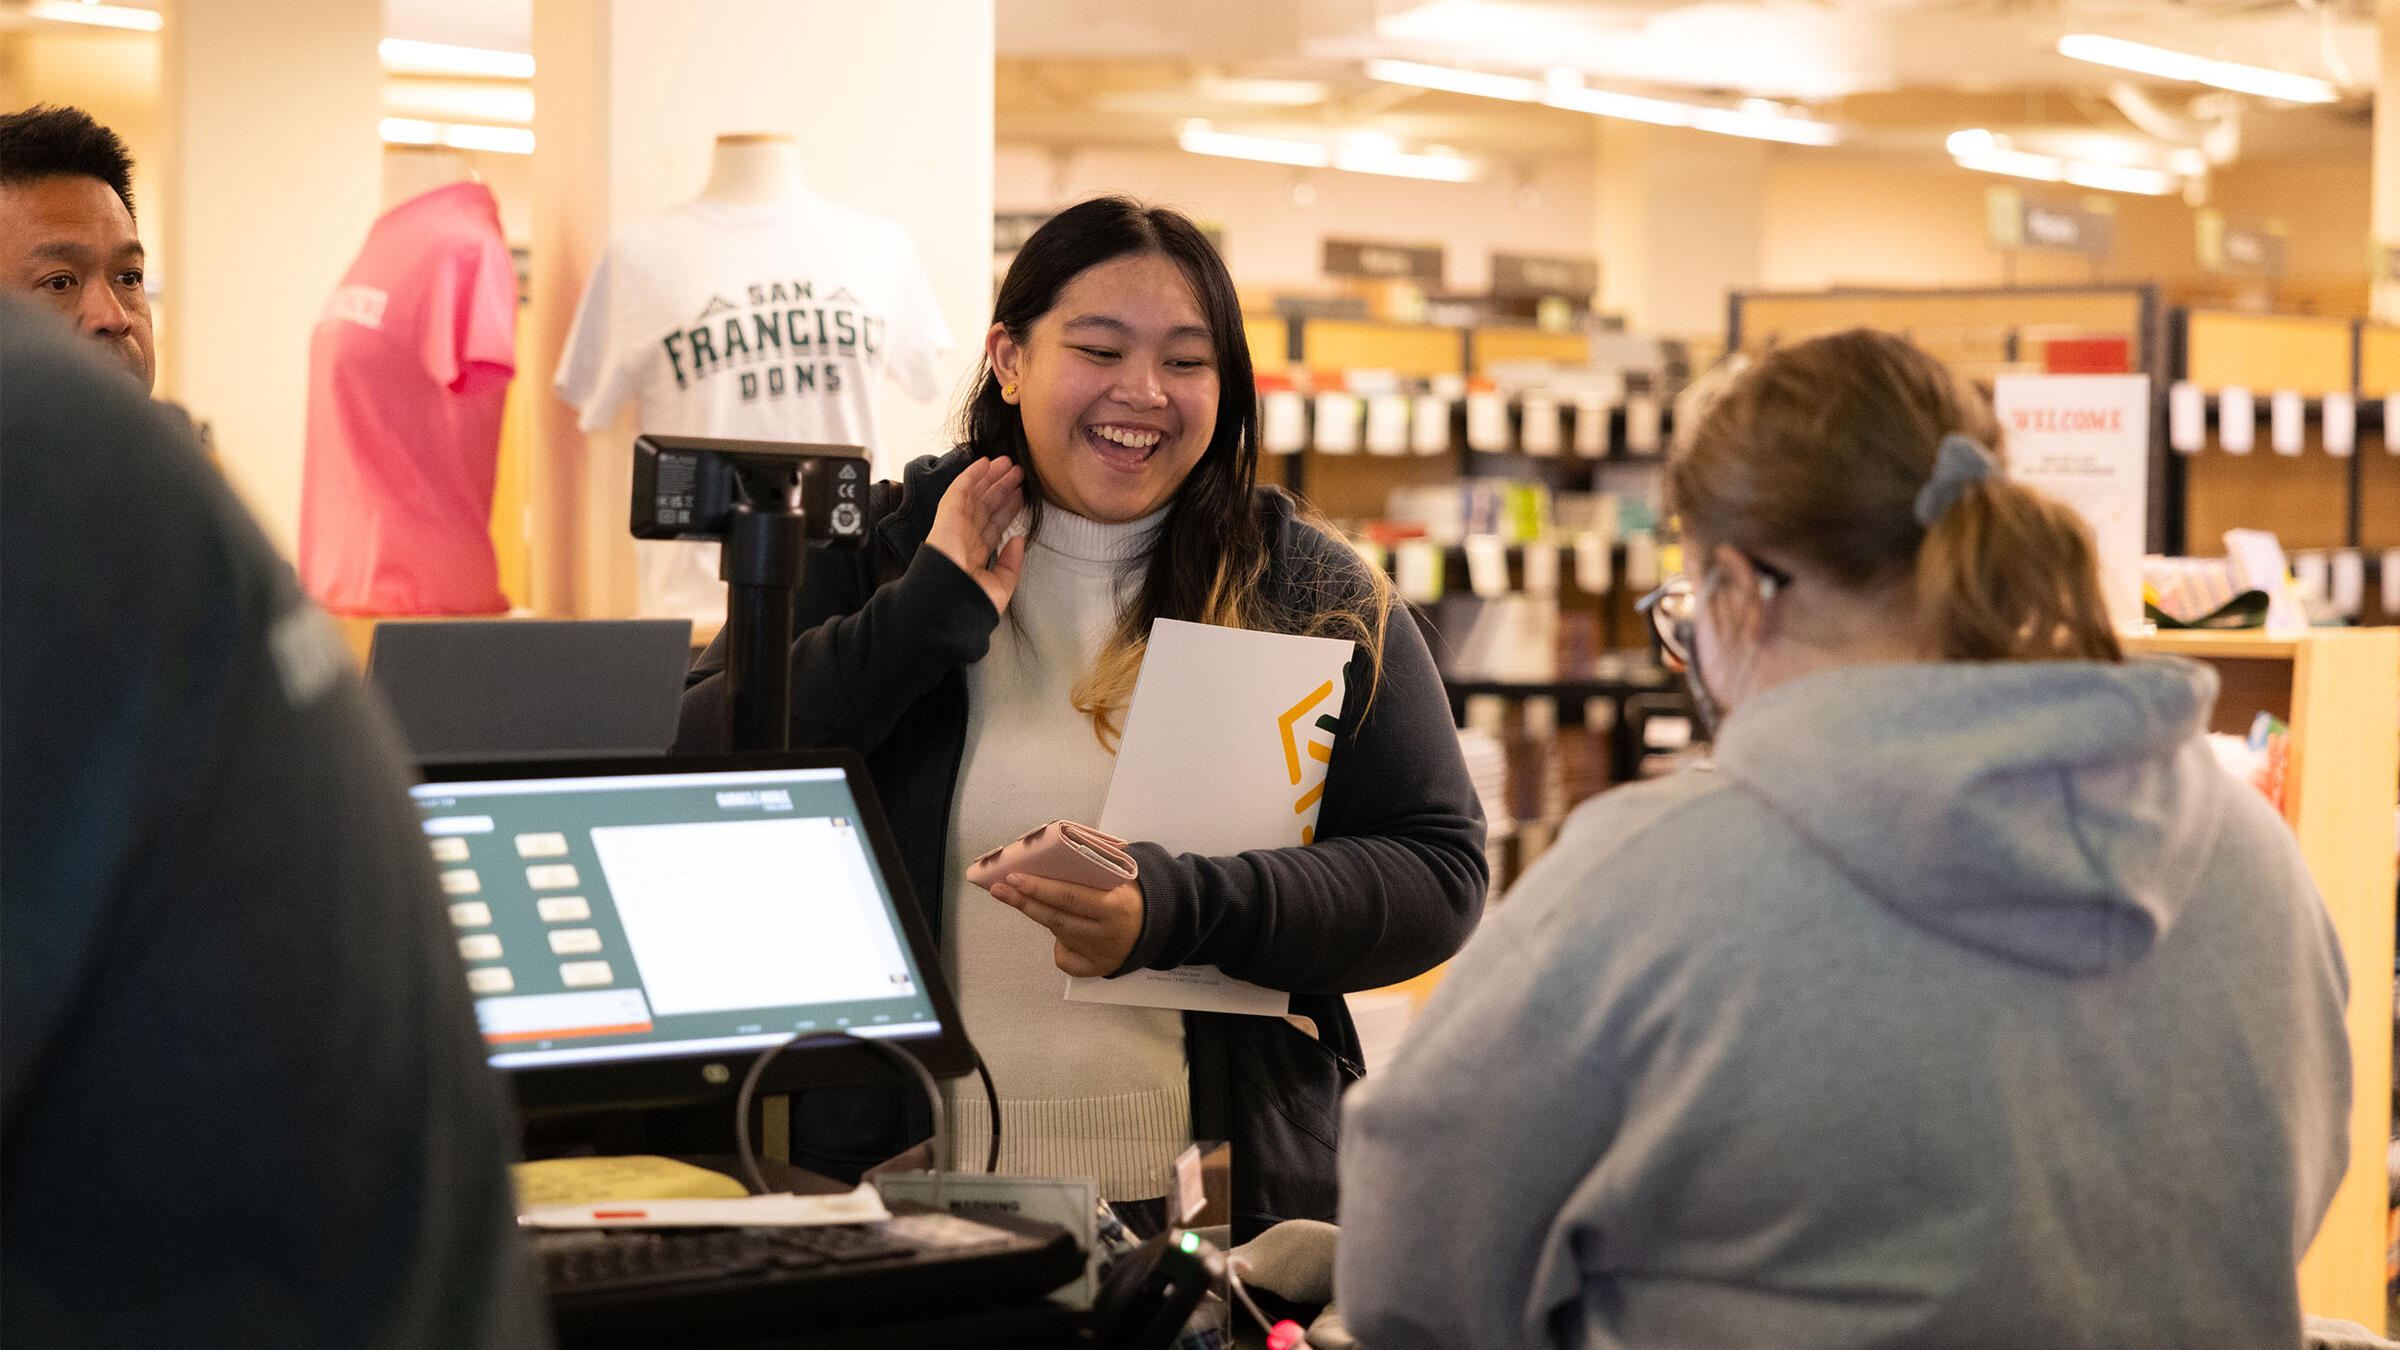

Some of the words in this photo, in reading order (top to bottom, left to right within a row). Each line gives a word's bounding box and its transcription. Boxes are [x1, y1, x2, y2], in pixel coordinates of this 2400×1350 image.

[747, 281, 812, 305] SAN
[663, 309, 885, 388] FRANCISC
[739, 363, 841, 398] DONS
[2011, 408, 2124, 432] WELCOME
